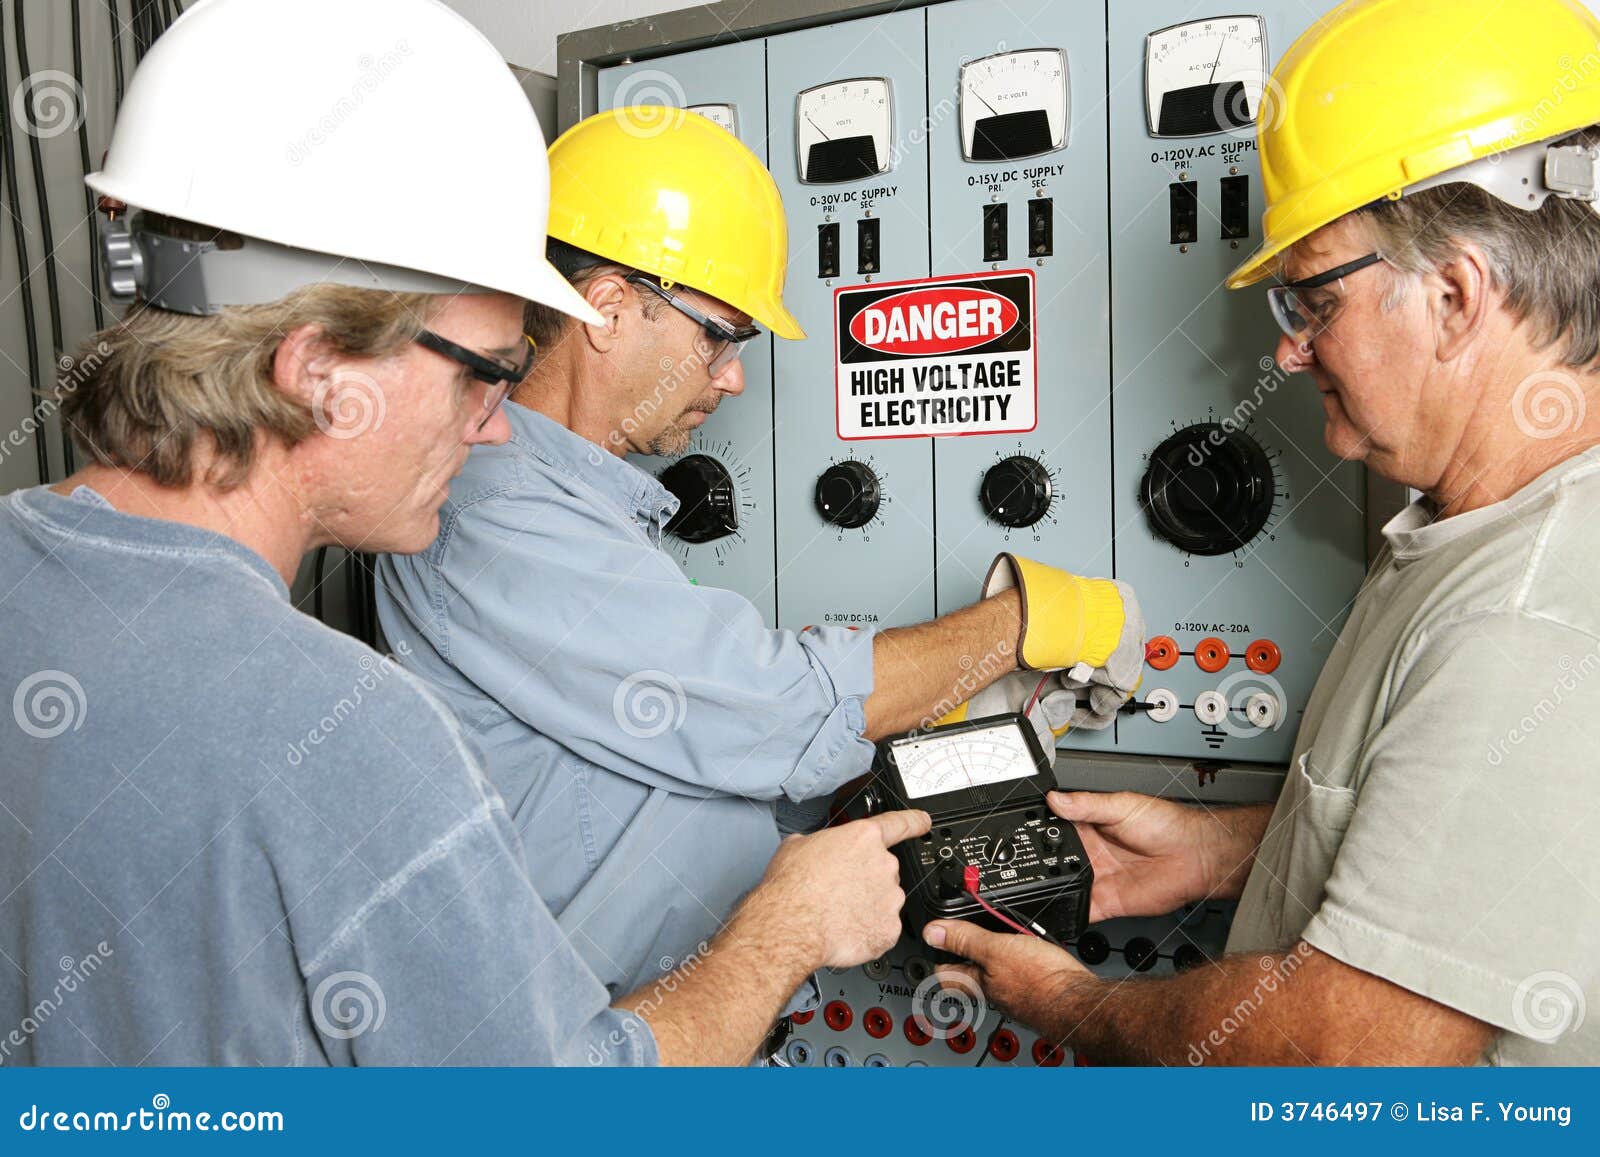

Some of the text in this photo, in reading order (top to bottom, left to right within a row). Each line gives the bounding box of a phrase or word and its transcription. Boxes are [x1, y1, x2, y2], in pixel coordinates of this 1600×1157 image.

[1151, 140, 1258, 163] 0-120V.AC SUPPL
[1223, 154, 1244, 163] SEC.
[1174, 161, 1192, 170] PRI.
[968, 164, 1064, 186] 0-15V.DC SUPPLY
[988, 184, 1004, 192] PRI.
[1032, 179, 1049, 188] SEC.
[810, 186, 898, 207] 0-30V.DC SUPPLY
[823, 205, 837, 213] PRI.
[860, 200, 875, 209] SEC.
[864, 298, 1003, 345] DANGER
[851, 360, 1021, 396] HIGH VOLTAGE
[860, 394, 1012, 428] ELECTRICITY
[1174, 622, 1250, 633] 0-120V.AC-20A
